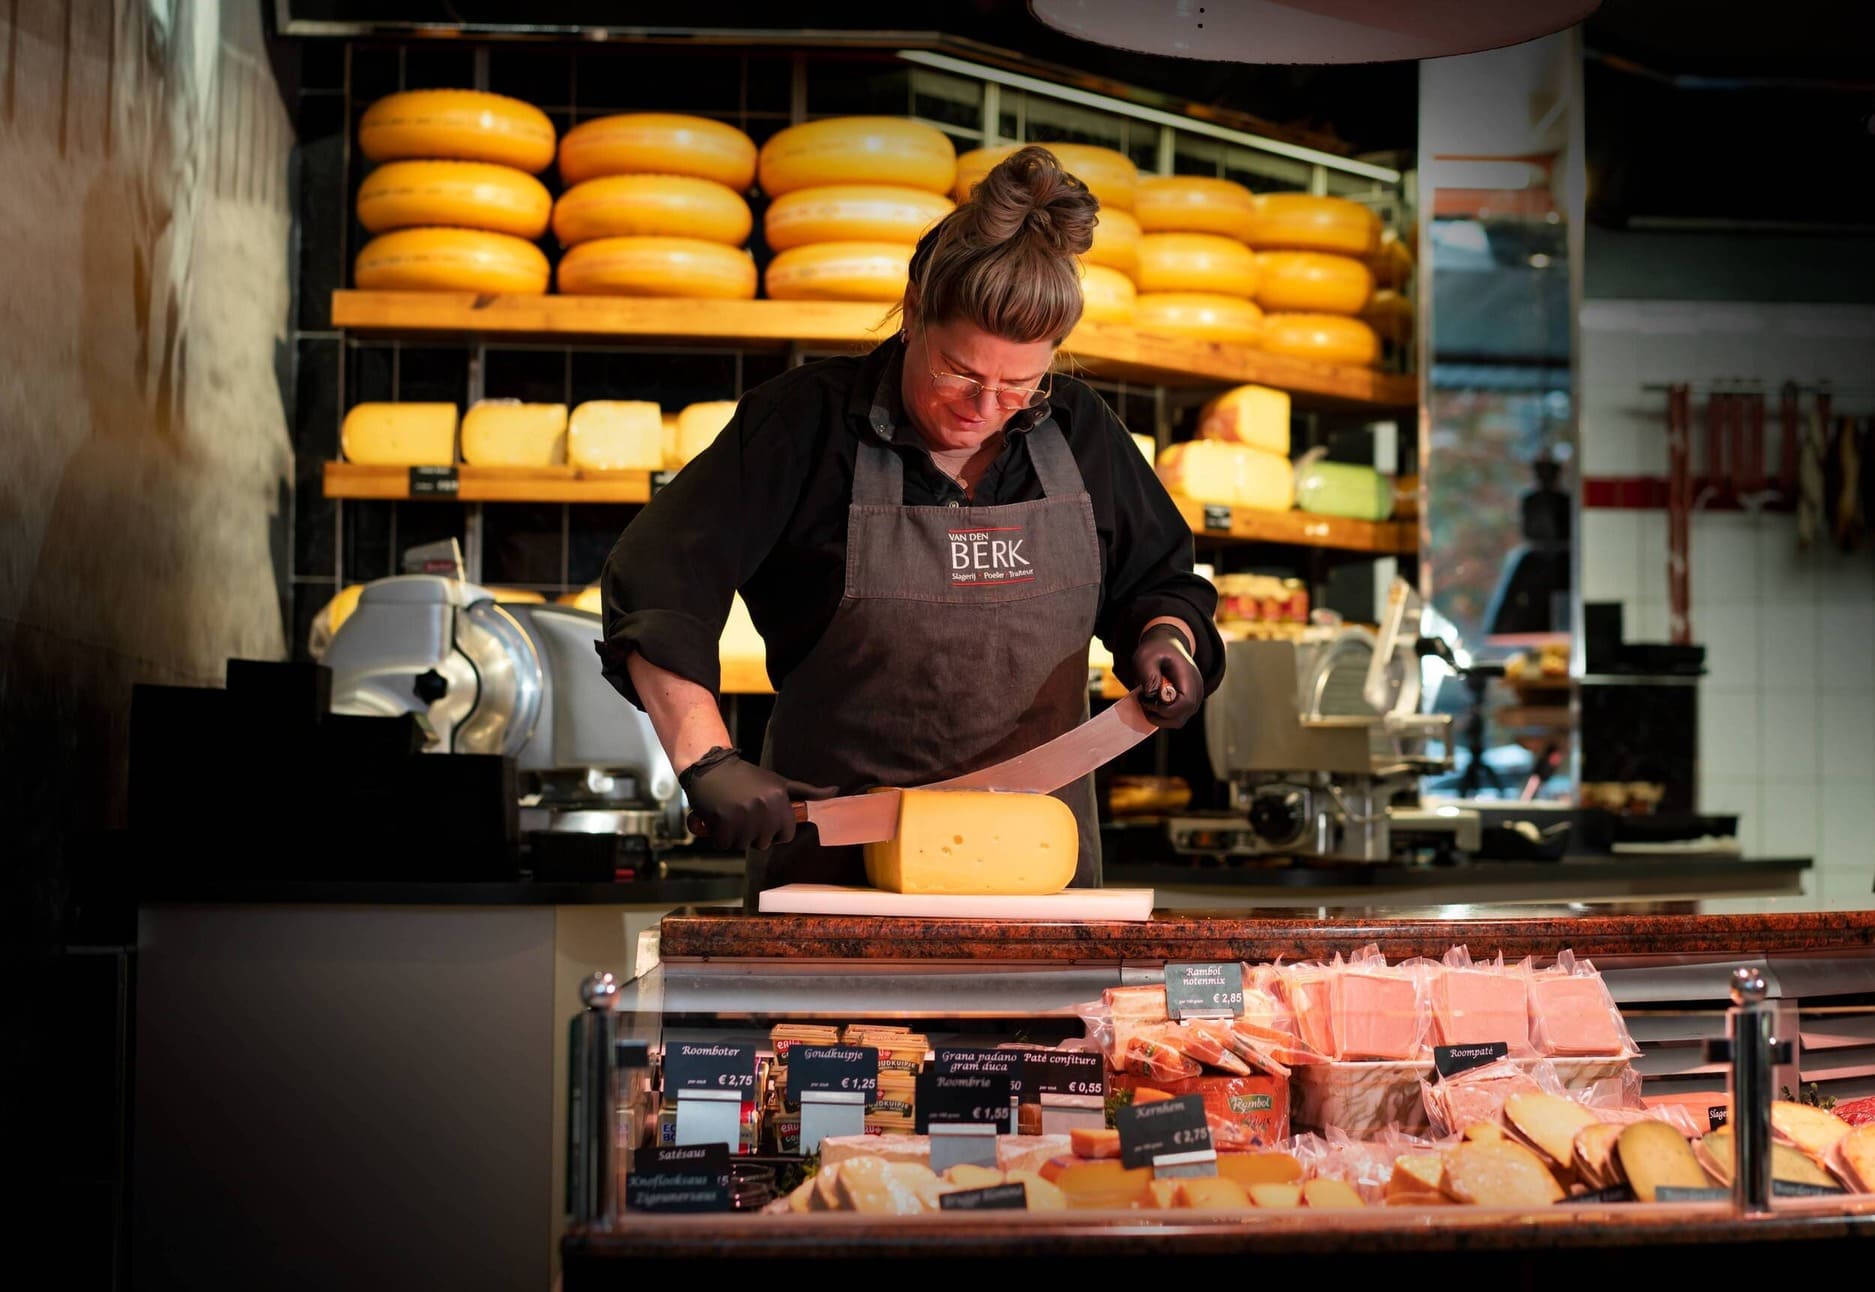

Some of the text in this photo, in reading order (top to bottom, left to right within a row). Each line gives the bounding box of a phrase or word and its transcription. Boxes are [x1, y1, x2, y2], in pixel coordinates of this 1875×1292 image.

[948, 532, 989, 541] VAN DEN
[951, 539, 1031, 569] BERK
[951, 572, 976, 581] Slagerij
[1185, 966, 1223, 977] Rambol
[1183, 977, 1226, 985] notenmix
[1213, 993, 1242, 1005] € 2,85
[682, 1045, 740, 1056] Roomboter
[804, 1047, 863, 1061] Goudkuipje
[1449, 1045, 1493, 1059] Roompaté
[942, 1051, 1017, 1064] Grana padano
[1024, 1053, 1096, 1067] Paté confiture
[950, 1062, 1008, 1073] gram duca
[718, 1074, 753, 1087] € 2,75
[841, 1078, 875, 1089] € 1,25
[936, 1076, 991, 1087] Roombrie
[1069, 1082, 1076, 1092] €
[1078, 1082, 1102, 1094] 0,55
[972, 1107, 981, 1119] €
[984, 1107, 1009, 1120] 1,55
[1174, 1129, 1208, 1144] € 2,75
[658, 1148, 706, 1160] Satésaus
